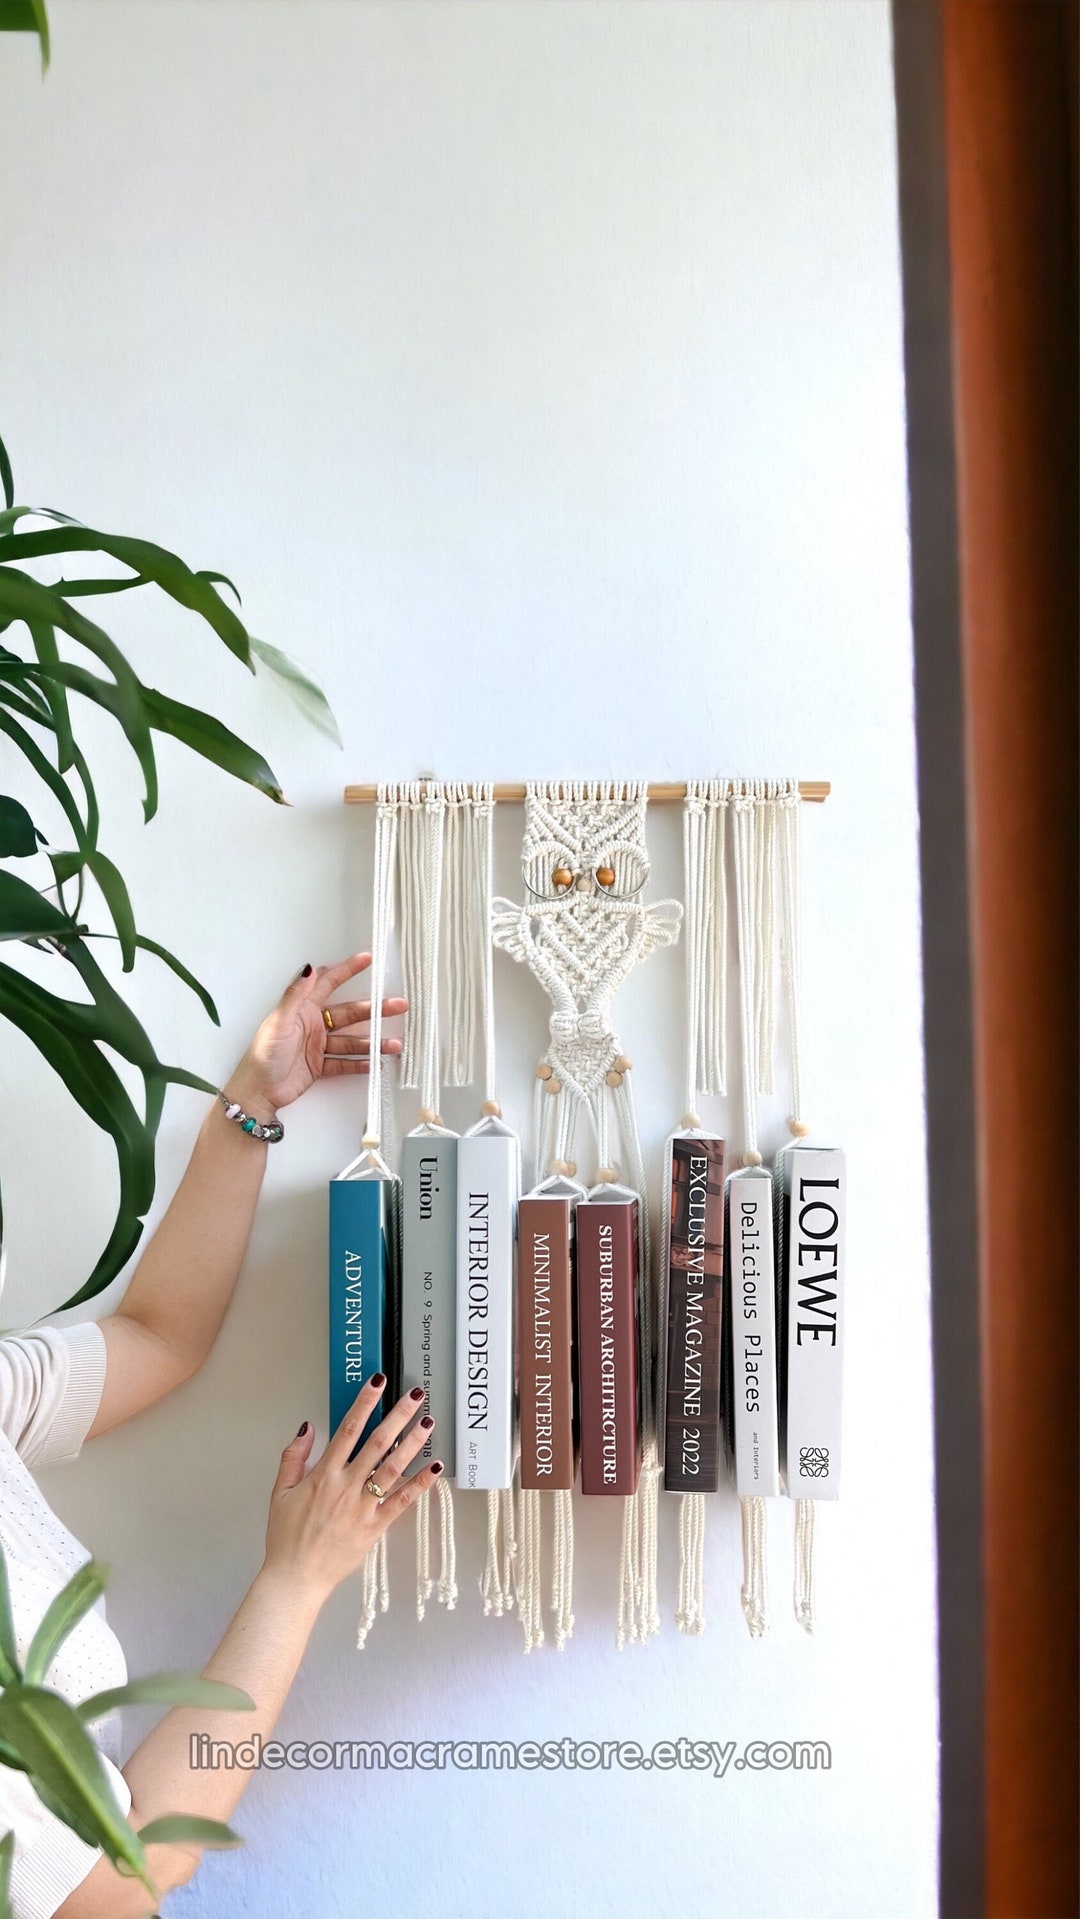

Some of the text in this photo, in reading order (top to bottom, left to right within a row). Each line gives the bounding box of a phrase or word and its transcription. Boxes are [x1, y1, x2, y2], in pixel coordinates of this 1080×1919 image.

[418, 1155, 438, 1221] Union
[796, 1177, 840, 1347] LOEWE
[344, 1250, 362, 1383] ADVENTURE
[421, 1271, 433, 1458] NO. 9 Spring and summ 018
[467, 1192, 490, 1432] INTERIOR DESIGN
[533, 1233, 554, 1477] MINIMALIST INTERIOR
[598, 1224, 618, 1484] SUBURBAN ARCHITRCTURE
[682, 1155, 708, 1475] EXCLUSIVE MAGAZINE 2022
[740, 1202, 762, 1413] Delicious Places
[468, 1441, 478, 1460] ART
